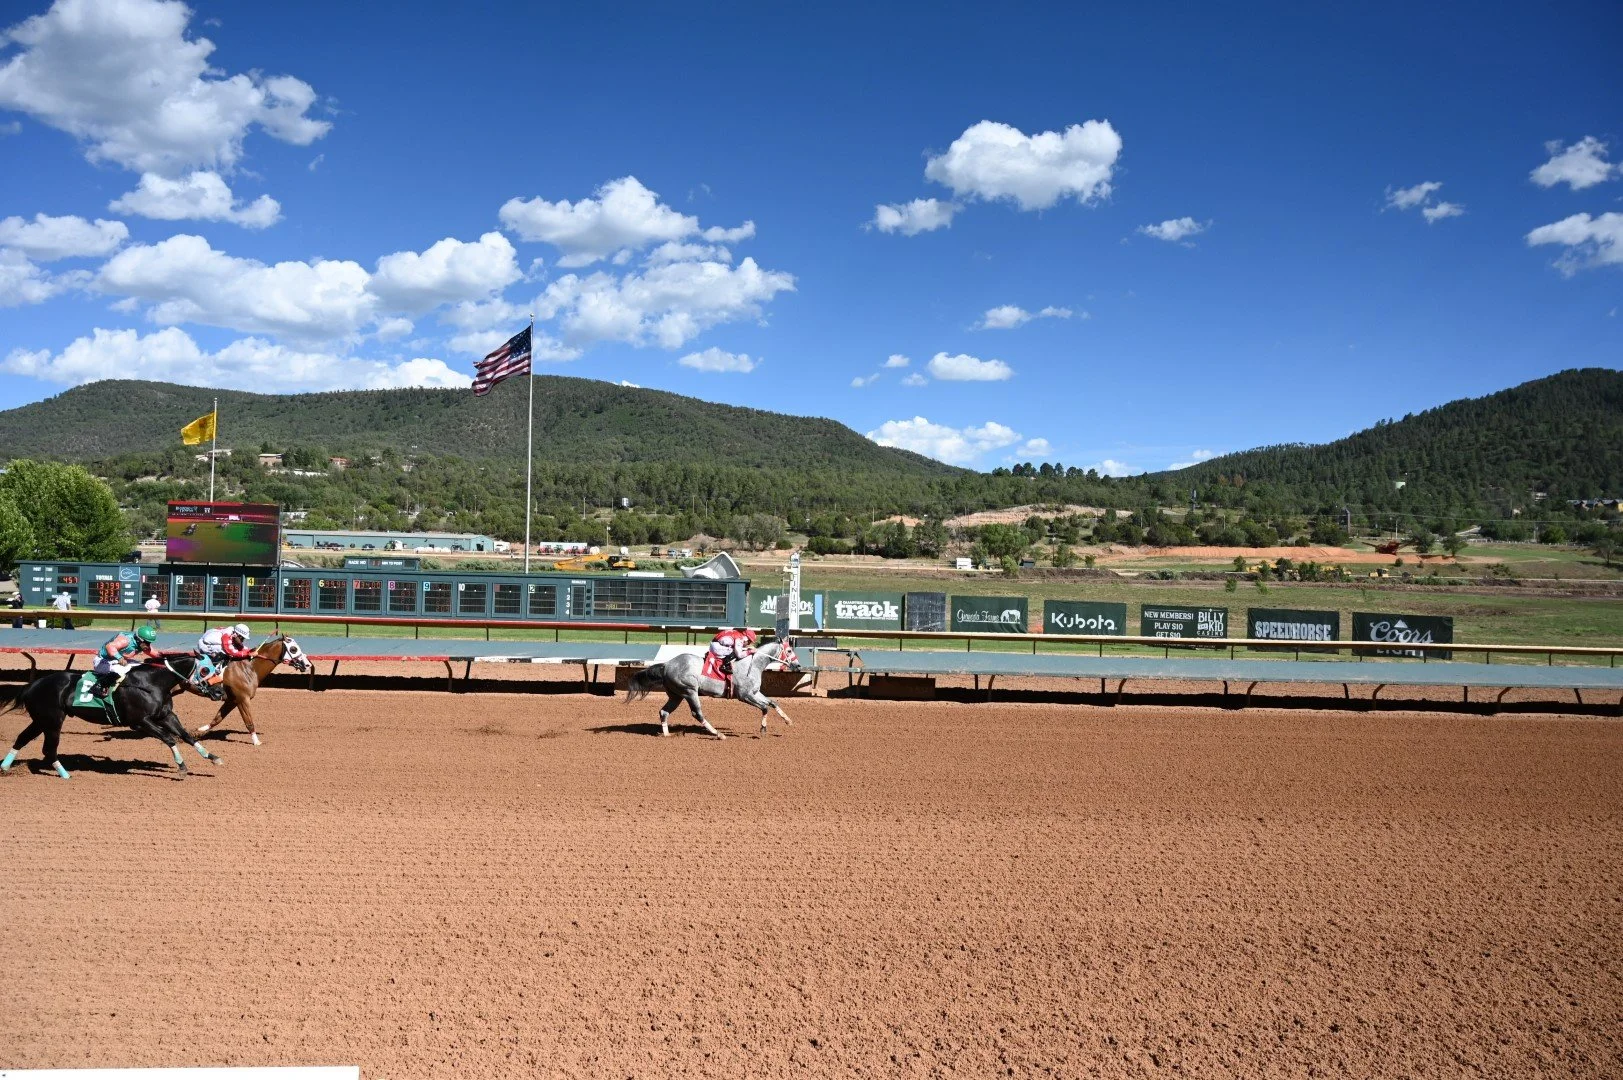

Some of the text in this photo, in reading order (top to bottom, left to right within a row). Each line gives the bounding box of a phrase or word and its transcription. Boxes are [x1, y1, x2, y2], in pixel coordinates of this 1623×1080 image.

[835, 600, 898, 618] track
[1160, 612, 1194, 620] MEMBERS!
[1052, 613, 1115, 630] Kubota
[1198, 612, 1224, 622] BILLY
[1154, 622, 1170, 630] PLAY
[1208, 621, 1224, 632] KID
[1255, 621, 1331, 641] SPEEDHORSE
[1370, 621, 1433, 643] Coors
